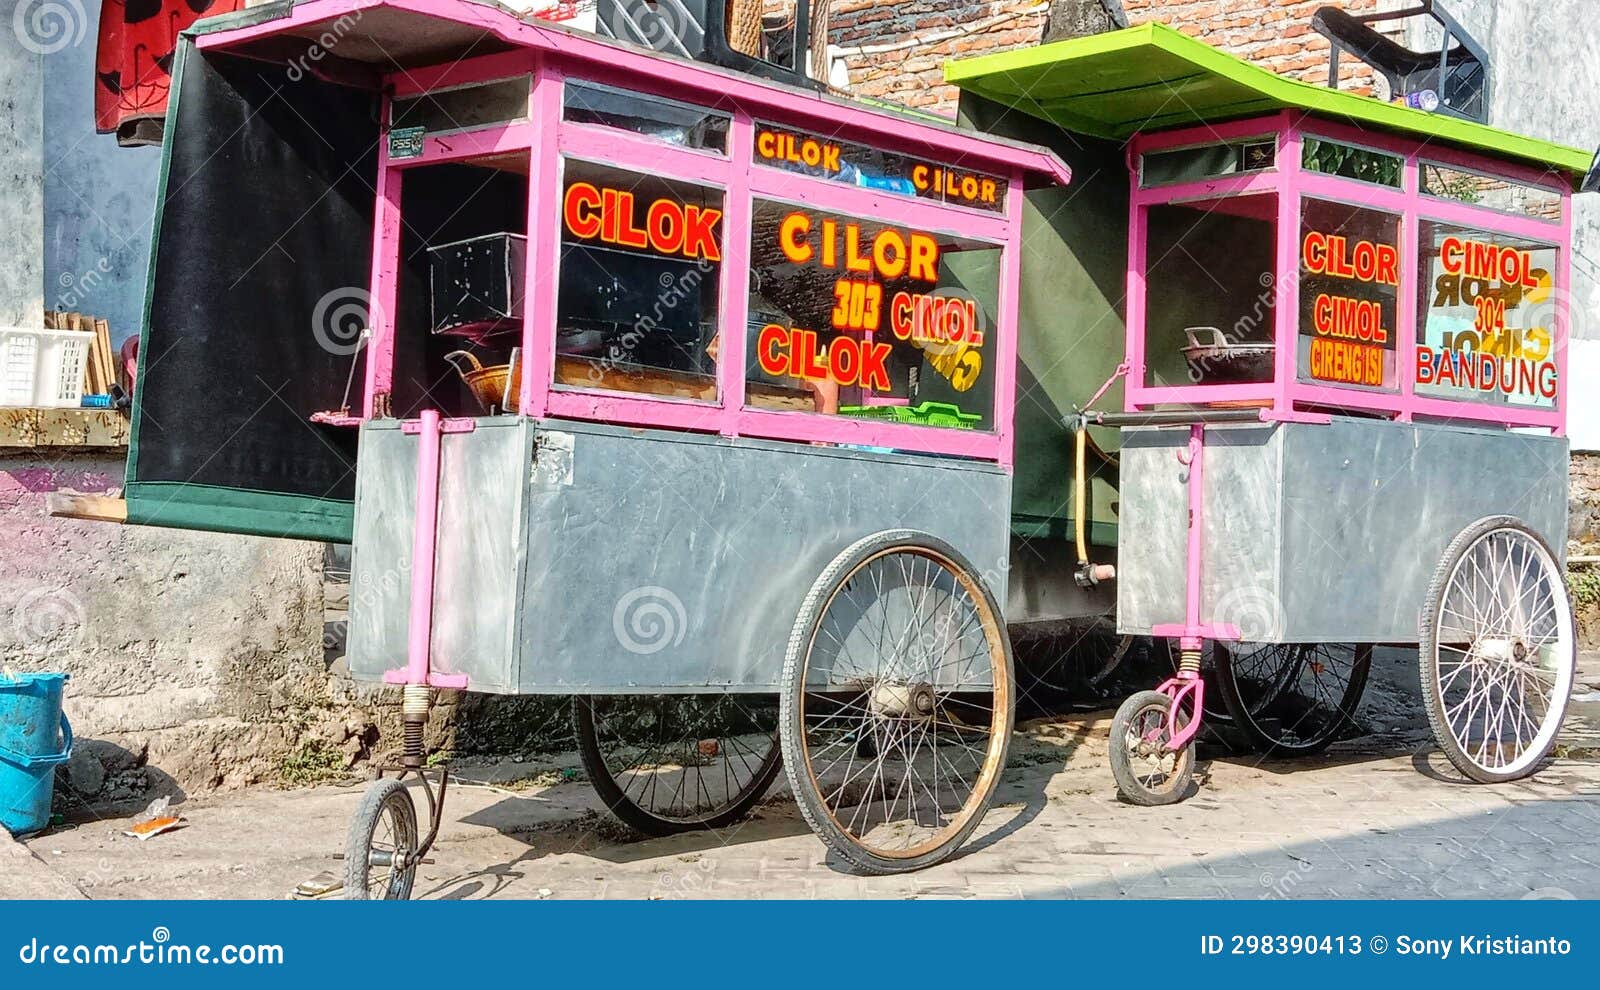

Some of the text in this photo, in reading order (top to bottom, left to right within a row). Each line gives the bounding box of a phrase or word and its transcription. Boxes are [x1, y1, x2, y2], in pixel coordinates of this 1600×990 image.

[757, 131, 997, 203] CILOK CILOR
[564, 182, 723, 261] CILOK
[779, 211, 940, 283] CILOR
[1303, 231, 1399, 286] CILOR
[1440, 237, 1539, 288] CIMOL
[831, 280, 883, 332] 303
[890, 291, 984, 347] CIMOL
[1313, 293, 1388, 343] CIMOL
[1474, 296, 1505, 334] 304
[757, 325, 892, 393] CILOK
[1415, 345, 1558, 398] BANDUNG
